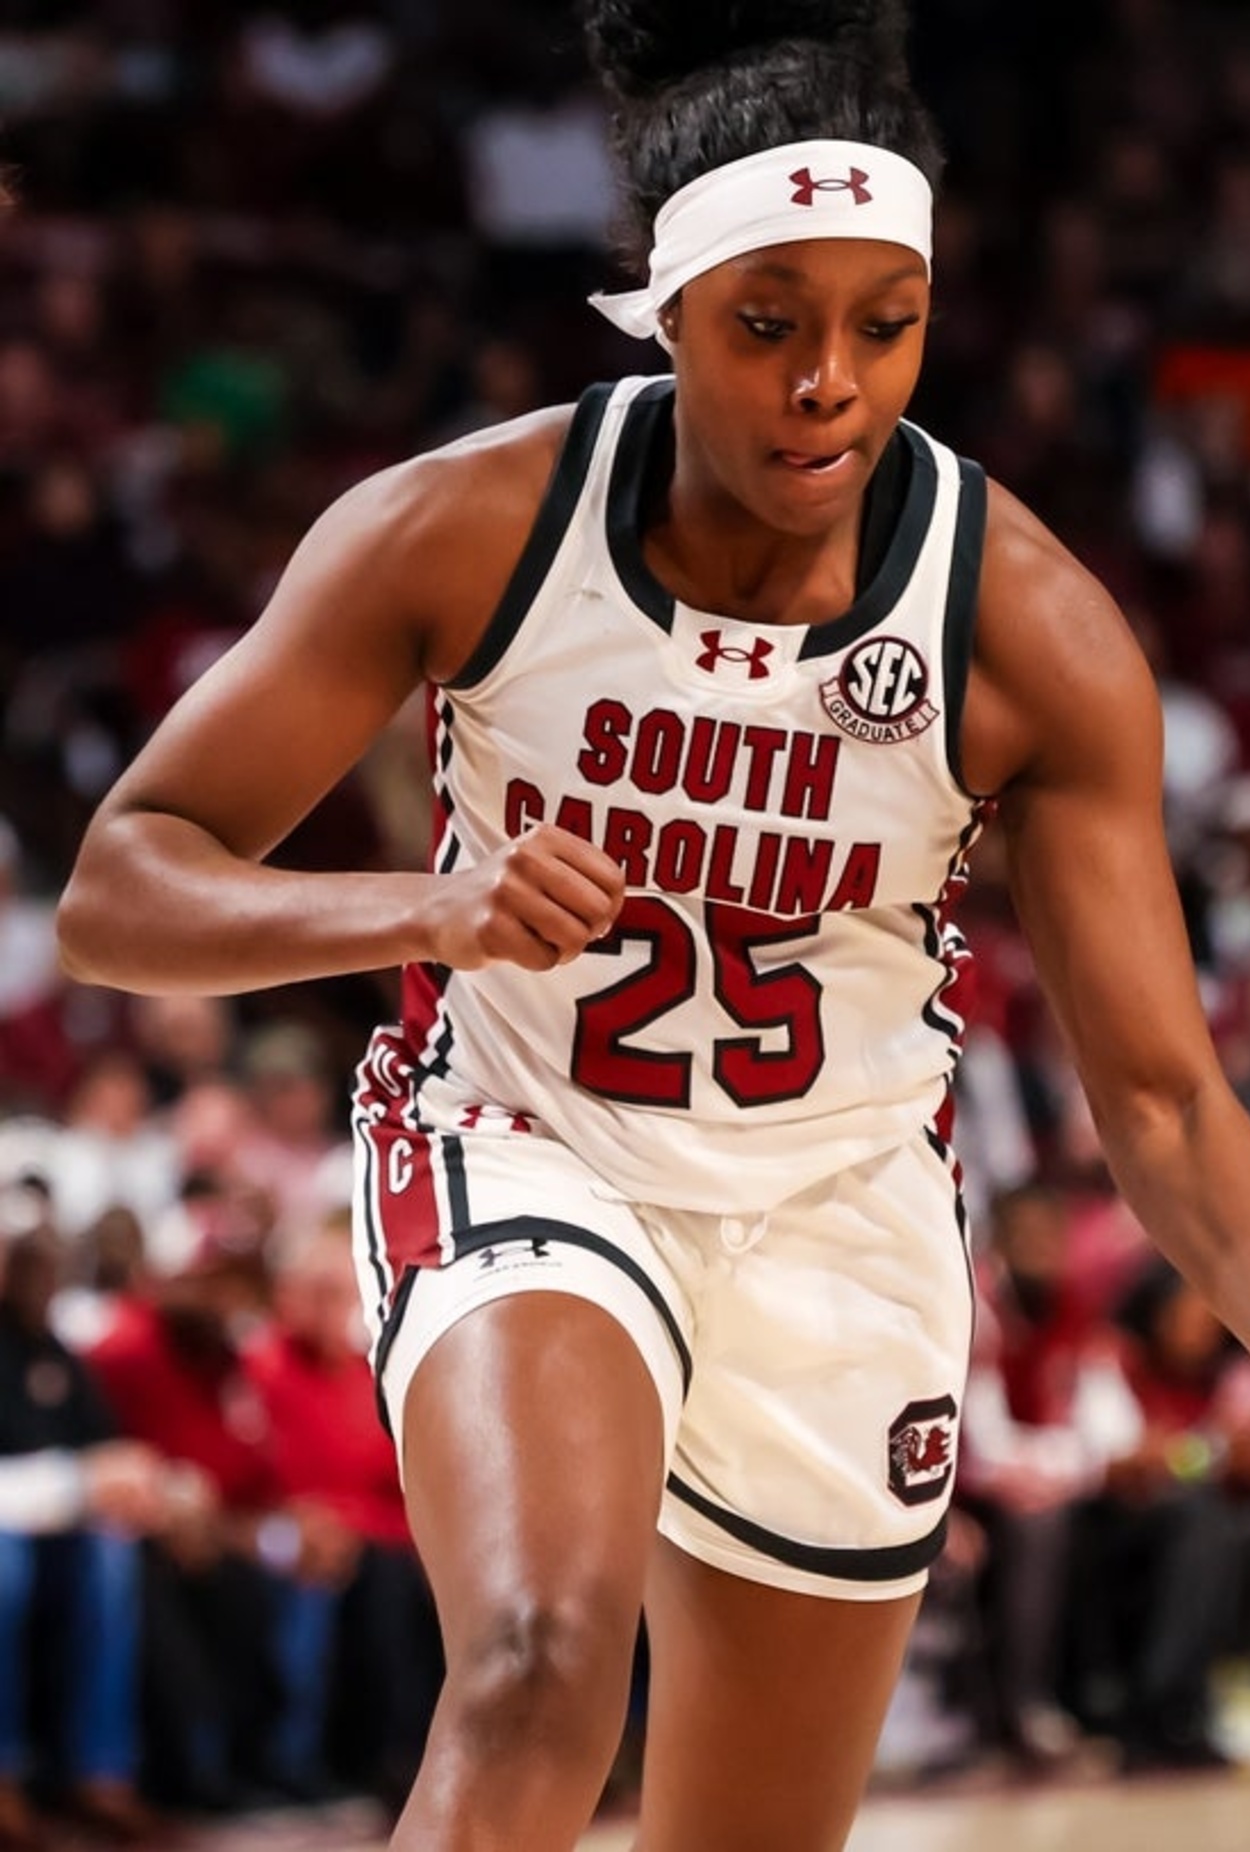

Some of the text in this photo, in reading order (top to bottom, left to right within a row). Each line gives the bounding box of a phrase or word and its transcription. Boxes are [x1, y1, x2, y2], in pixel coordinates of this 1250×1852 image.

[829, 699, 922, 741] GRADUATE
[847, 640, 923, 718] SEC
[577, 697, 841, 822] SOUTH
[570, 894, 825, 1110] 25
